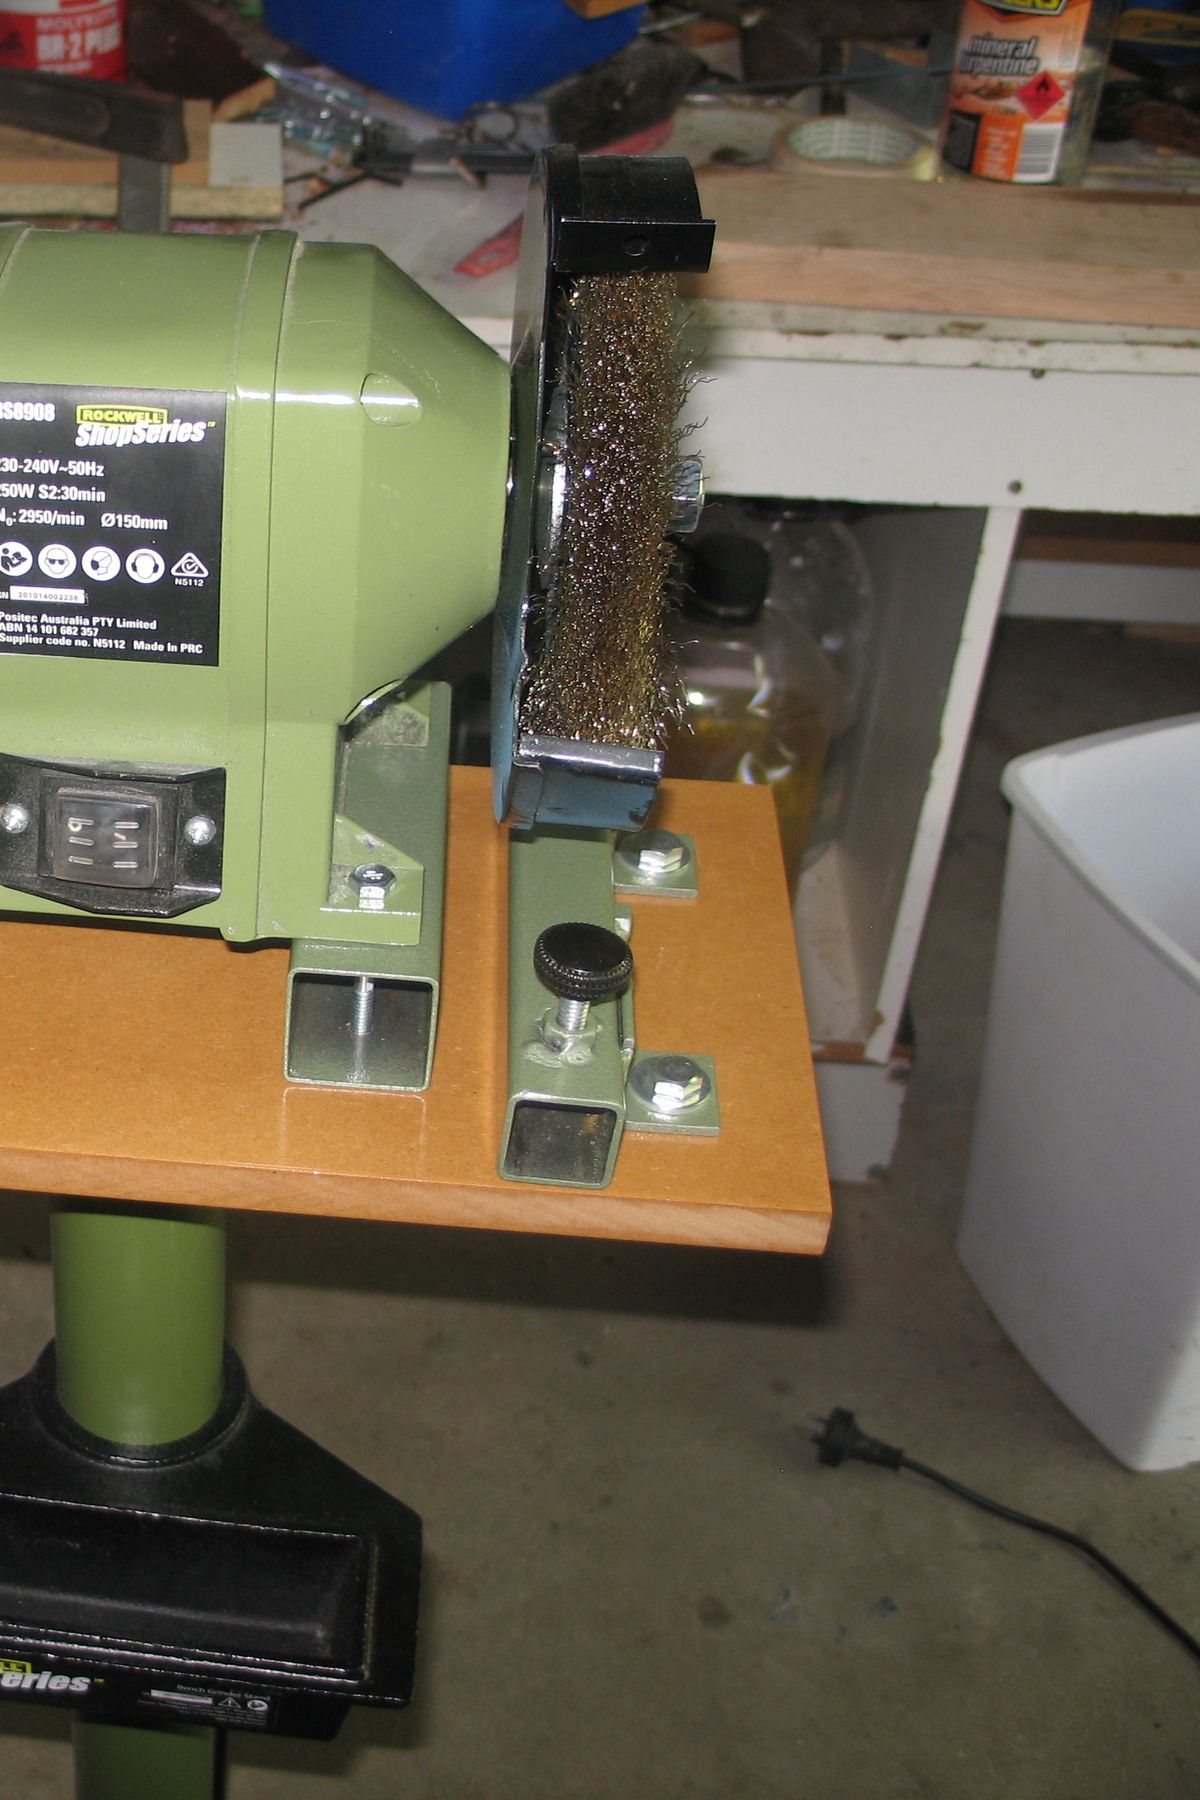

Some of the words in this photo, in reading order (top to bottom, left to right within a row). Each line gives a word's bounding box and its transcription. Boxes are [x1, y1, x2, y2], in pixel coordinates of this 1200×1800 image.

[968, 33, 1039, 57] mineral
[82, 409, 162, 424] ROCKWELL
[75, 419, 207, 448] ShopSeries
[38, 485, 106, 502] S2:30min
[175, 577, 204, 587] N5112
[25, 623, 38, 634] 14
[40, 625, 57, 635] 101
[60, 626, 79, 636] 682
[80, 627, 99, 637] 357
[40, 613, 90, 626] Australia
[92, 617, 114, 628] PTY
[116, 618, 157, 630] Limited
[0, 633, 43, 646] Supplier
[46, 636, 72, 646] code
[74, 639, 91, 648] no.
[93, 639, 126, 649] N5112
[133, 641, 164, 652] Made
[180, 643, 203, 654] PRC
